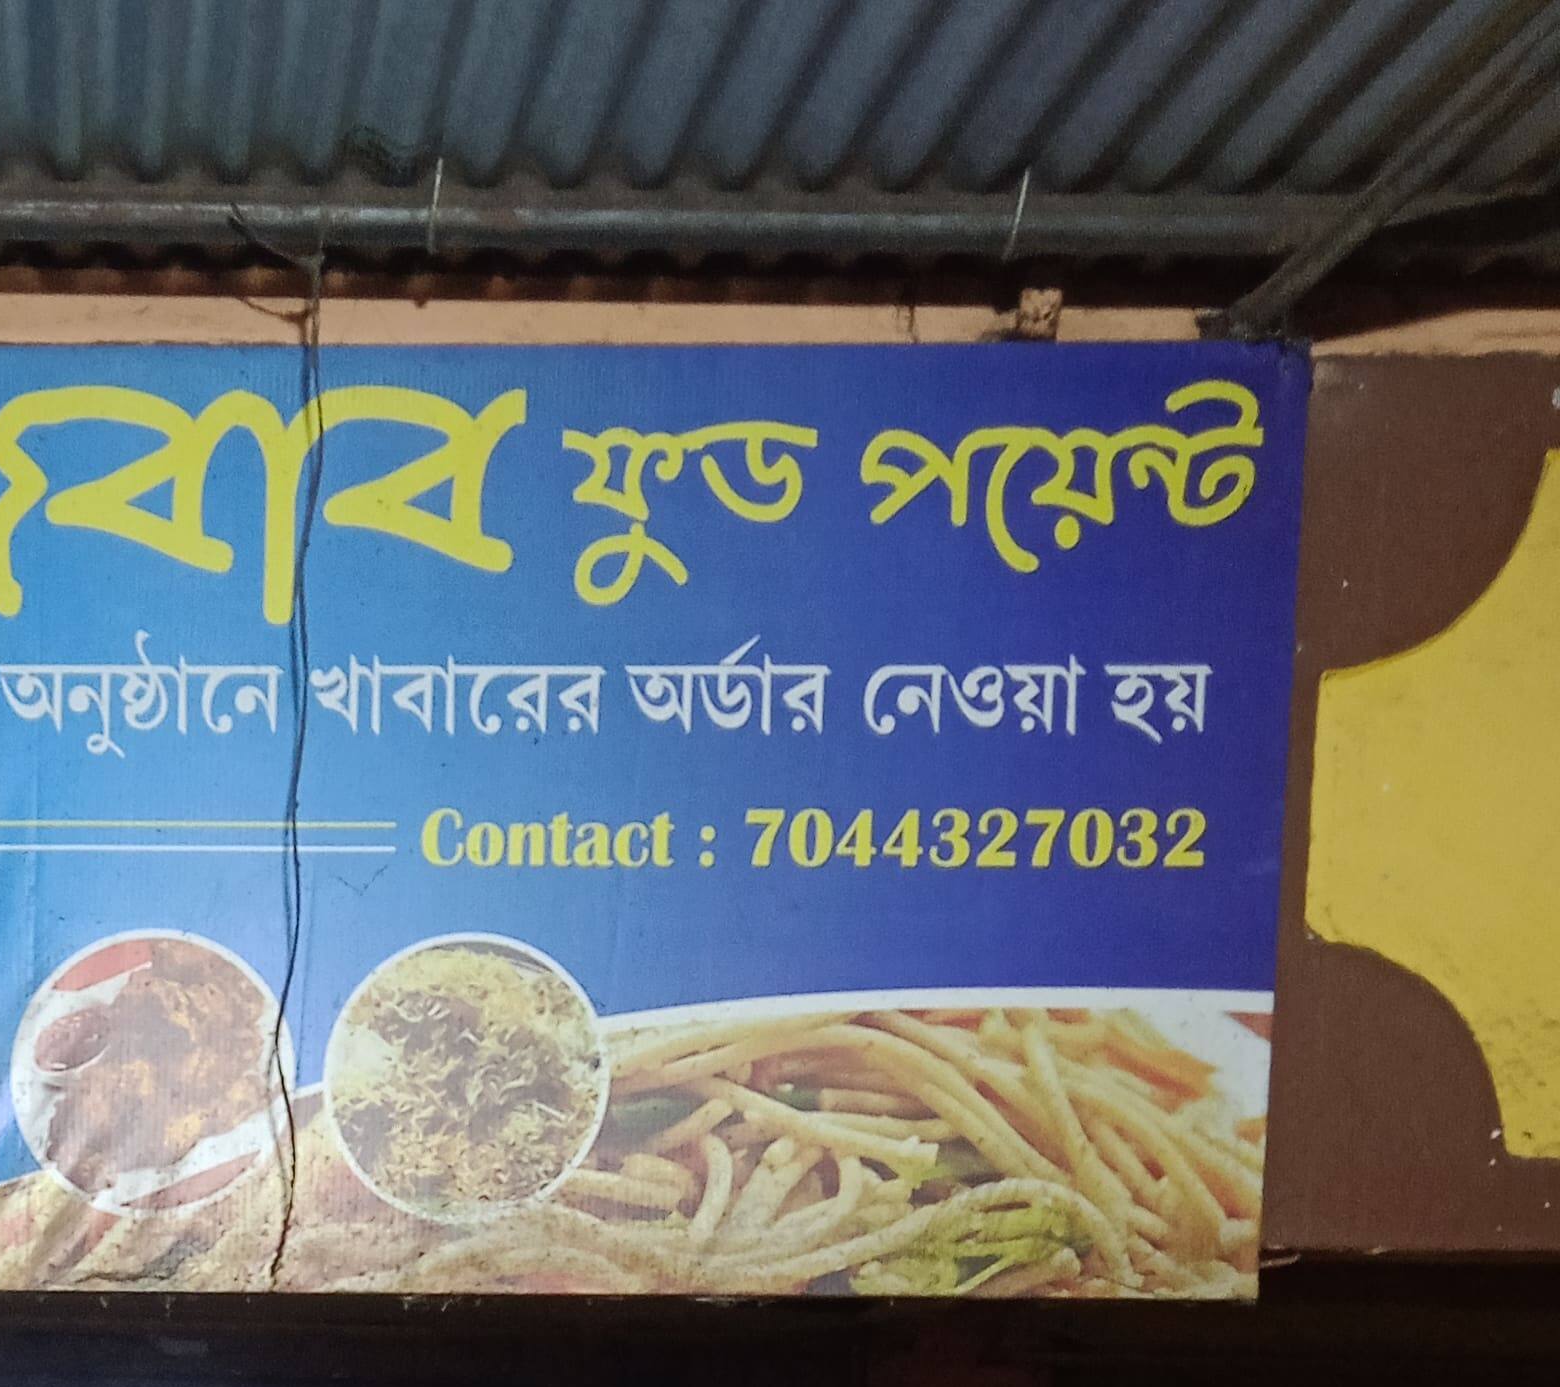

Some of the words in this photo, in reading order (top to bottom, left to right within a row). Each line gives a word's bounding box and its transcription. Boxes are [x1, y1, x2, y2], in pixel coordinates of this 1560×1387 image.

[562, 420, 818, 606] ফুড
[861, 379, 1264, 572] পয়েন্ট
[309, 653, 606, 736] খাবারের
[626, 635, 830, 735] অর্ডার
[862, 655, 1084, 737] নেওয়া
[1105, 661, 1211, 742] হয়
[421, 807, 676, 868] Contact
[744, 807, 1206, 869] 7044327032
